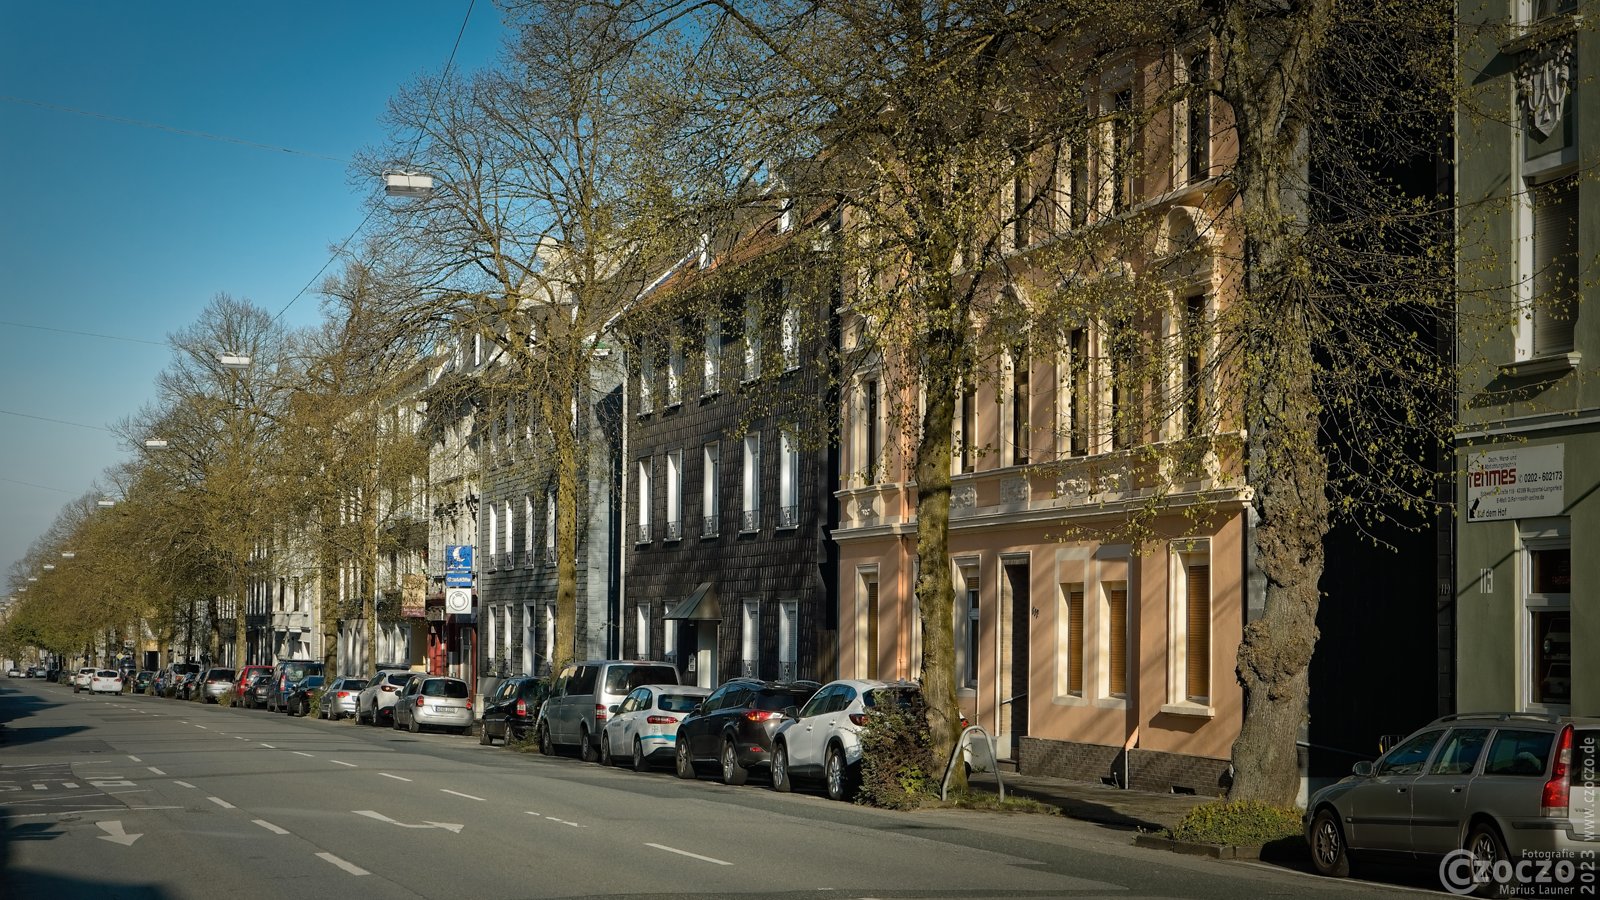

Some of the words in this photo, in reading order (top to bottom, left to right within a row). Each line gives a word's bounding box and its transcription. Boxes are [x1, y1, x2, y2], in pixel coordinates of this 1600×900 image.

[1524, 473, 1537, 483] 0202
[1542, 471, 1563, 481] 602173
[1486, 509, 1496, 517] dem
[1497, 508, 1507, 516] Hof
